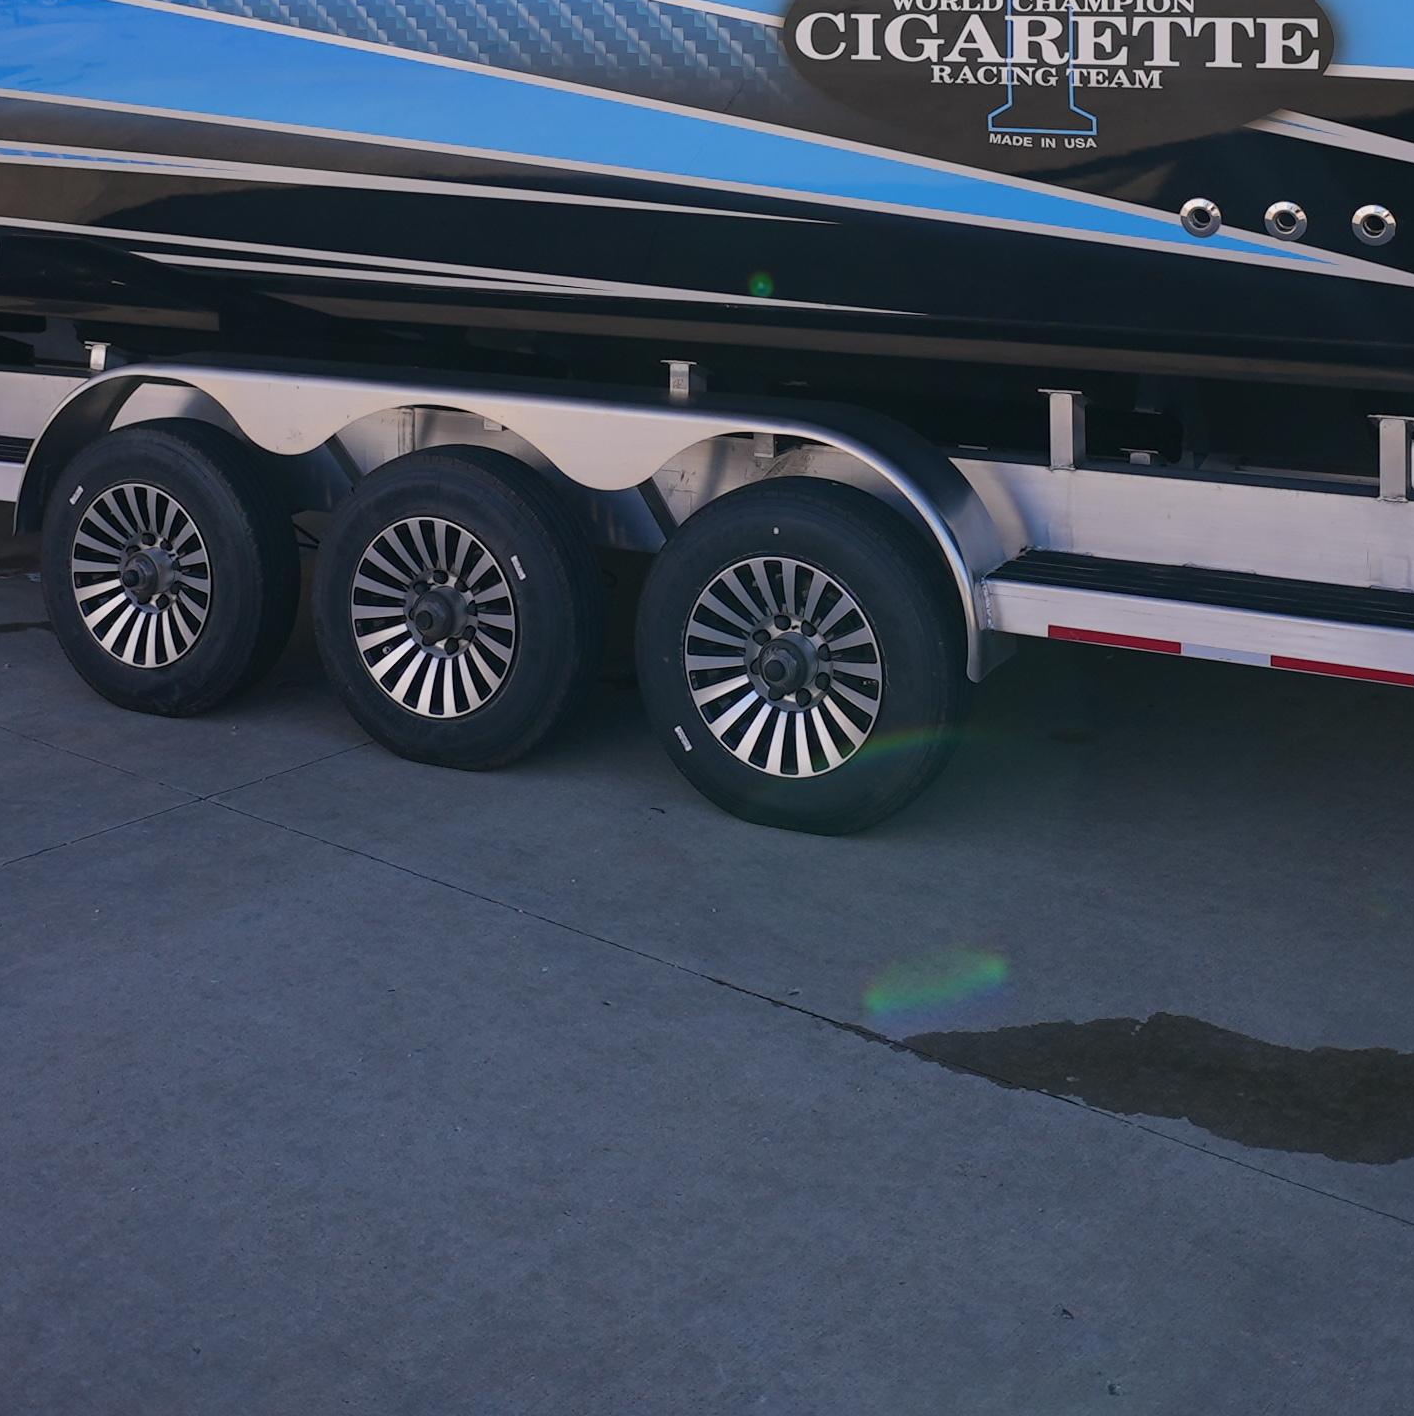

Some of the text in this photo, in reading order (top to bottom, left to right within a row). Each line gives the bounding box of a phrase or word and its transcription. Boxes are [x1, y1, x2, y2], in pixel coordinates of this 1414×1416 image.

[794, 11, 1321, 71] CIGARETTE
[930, 64, 1164, 90] RACING TEAM
[989, 133, 1098, 149] MADE IN USA
